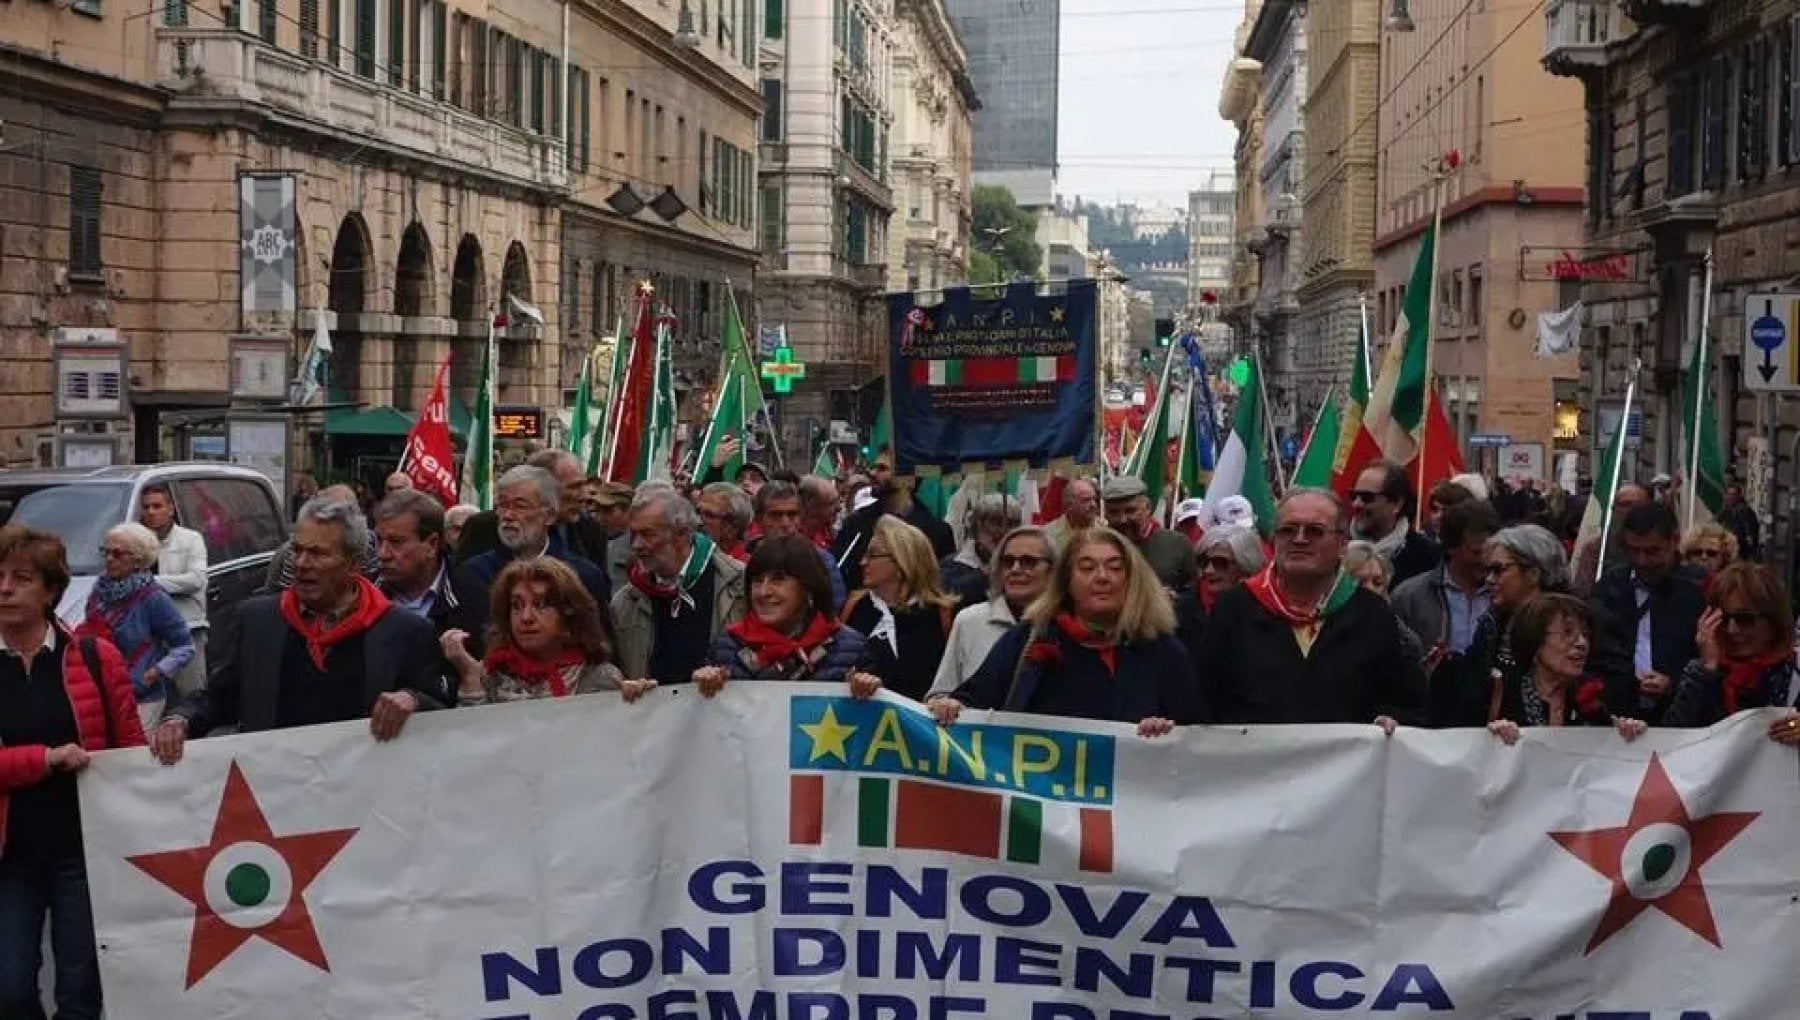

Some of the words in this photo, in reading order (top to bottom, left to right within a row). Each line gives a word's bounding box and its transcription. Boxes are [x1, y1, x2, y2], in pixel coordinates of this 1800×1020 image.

[863, 707, 1106, 799] A.N.P.I.
[687, 860, 1236, 947] GENOVA
[481, 926, 731, 1001] NON
[773, 928, 1455, 1011] DIMENTICA
